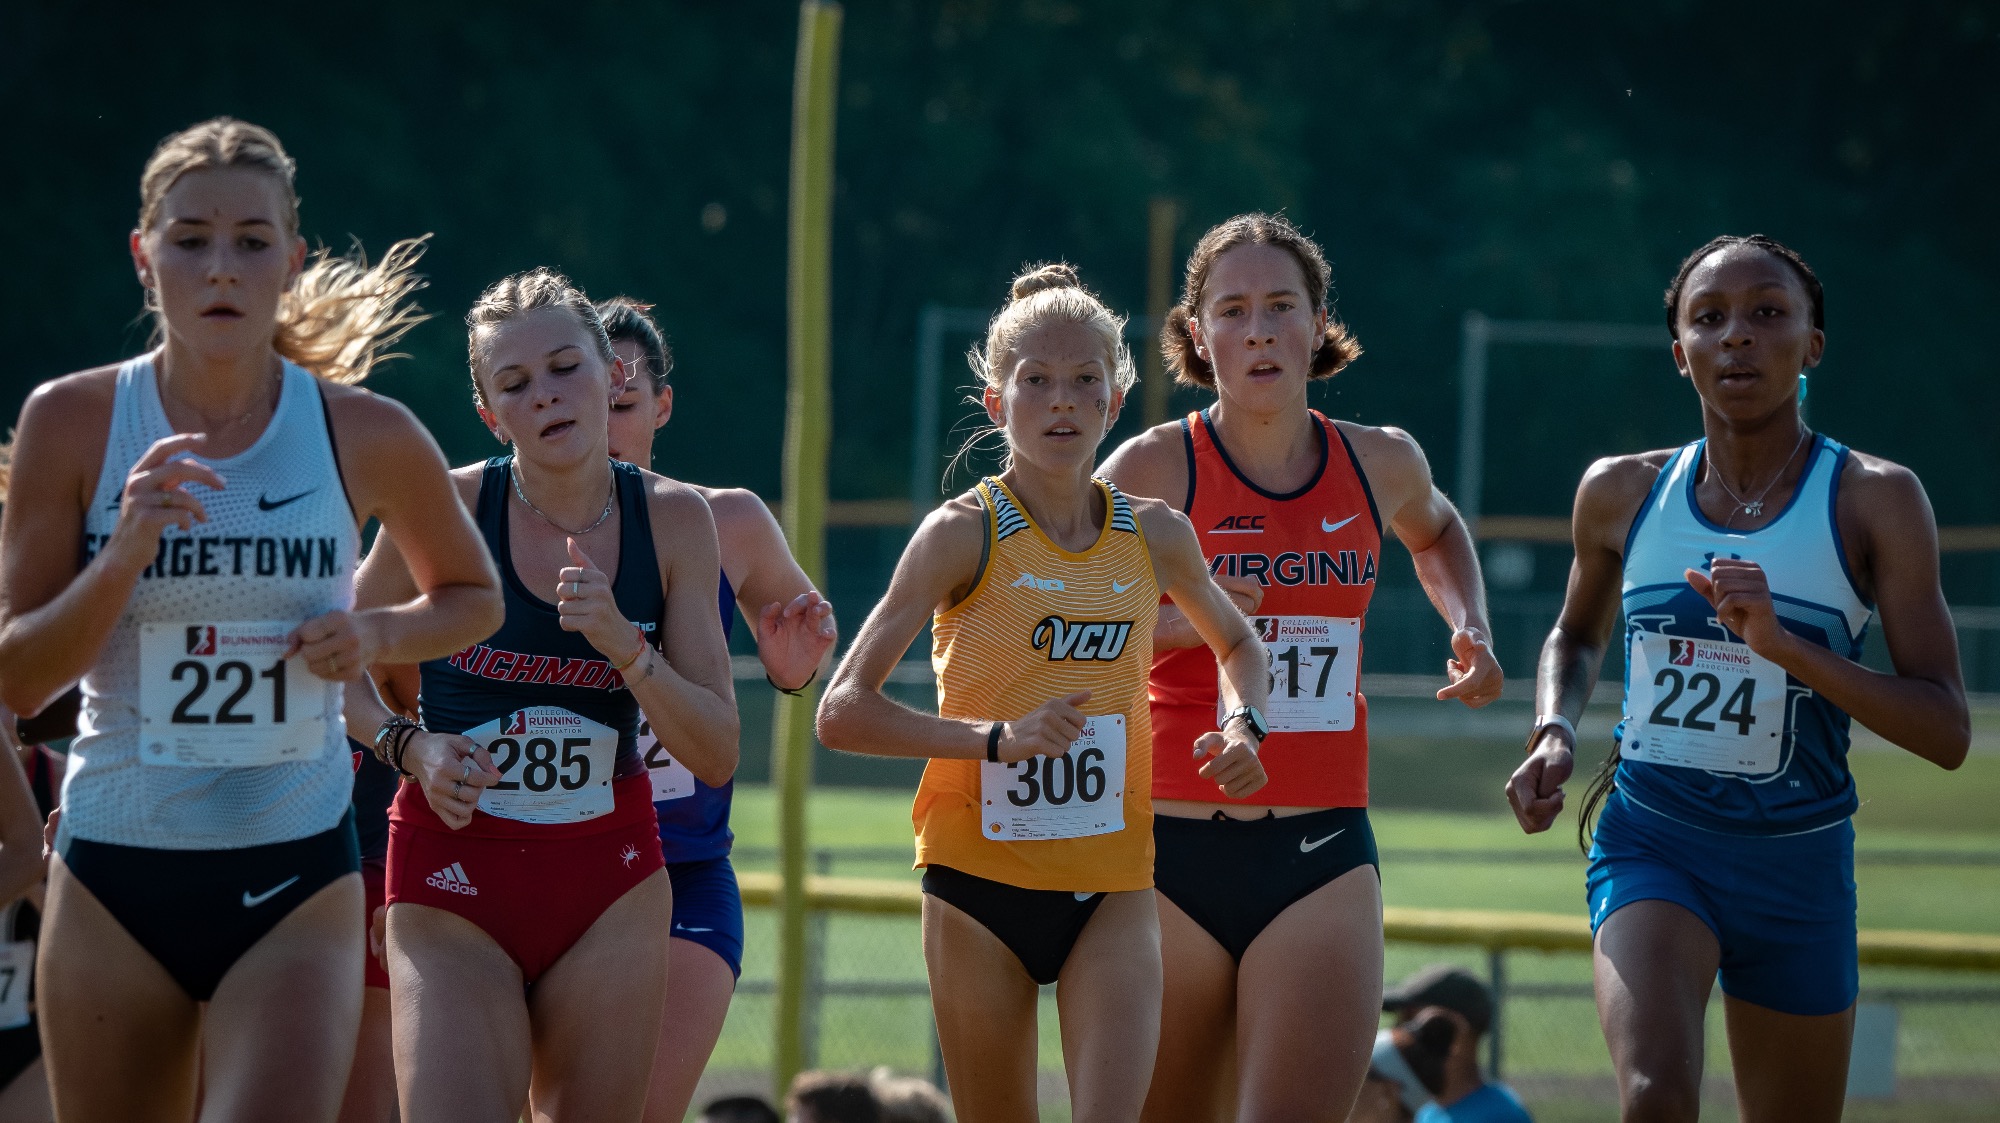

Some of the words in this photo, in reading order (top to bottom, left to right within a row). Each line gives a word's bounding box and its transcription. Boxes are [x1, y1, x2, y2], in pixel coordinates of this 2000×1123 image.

[1214, 515, 1266, 530] ACC
[84, 533, 336, 578] GRGETOWN
[629, 621, 657, 632] 10
[1280, 626, 1329, 635] RUNNING
[221, 635, 285, 647] RUNNING
[1032, 615, 1135, 662] VCU
[1697, 642, 1750, 655] COLLEGIATE
[448, 643, 625, 690] RICHMON
[1697, 649, 1751, 665] RUNNING
[1268, 645, 1339, 698] 17
[1696, 662, 1751, 675] ASSOCIATION
[170, 660, 287, 724] 221
[1648, 668, 1756, 736] 224
[528, 716, 581, 726] RUNNING
[486, 737, 592, 793] 285
[1006, 747, 1107, 808] 306
[426, 875, 478, 897] adidas
